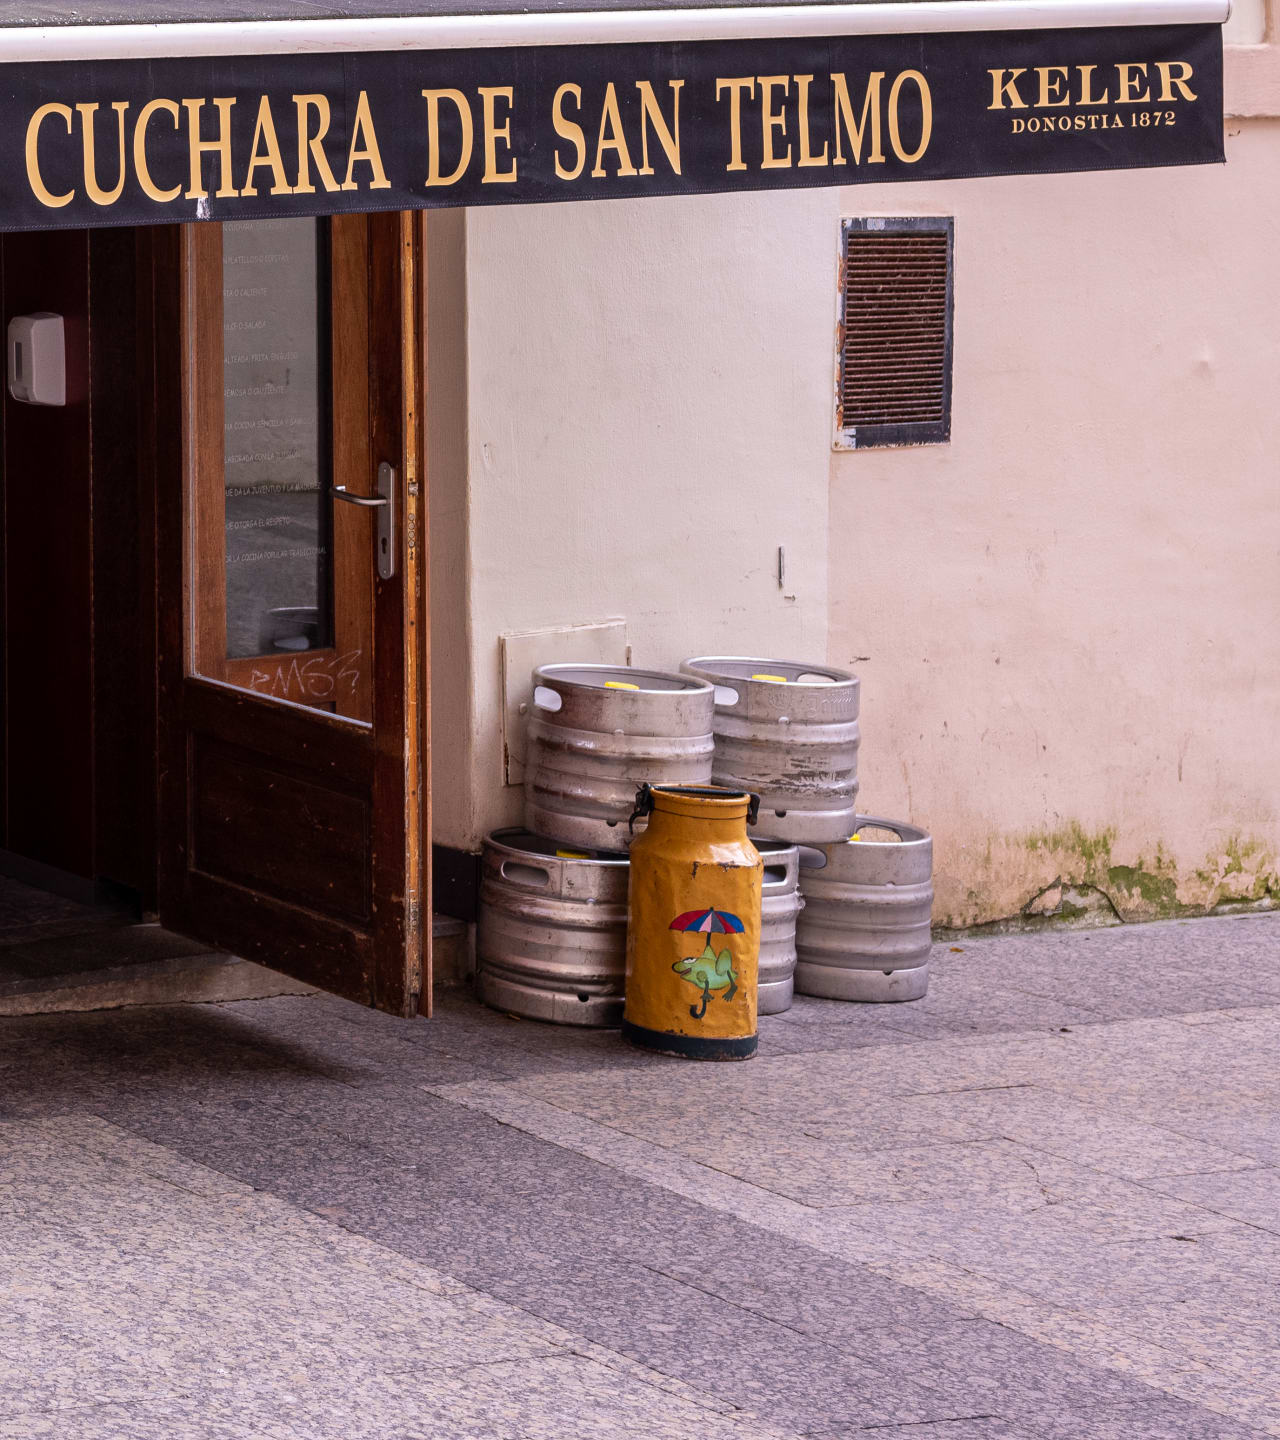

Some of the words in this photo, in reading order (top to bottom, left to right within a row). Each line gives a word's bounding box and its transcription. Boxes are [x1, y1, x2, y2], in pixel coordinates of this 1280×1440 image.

[987, 61, 1198, 110] KELER
[25, 88, 392, 208] CUCHARA
[421, 85, 518, 188] DE
[551, 77, 685, 182] SAN
[715, 68, 934, 173] TELMO
[1011, 112, 1125, 133] DONOSTIA
[1131, 110, 1177, 128] 1872
